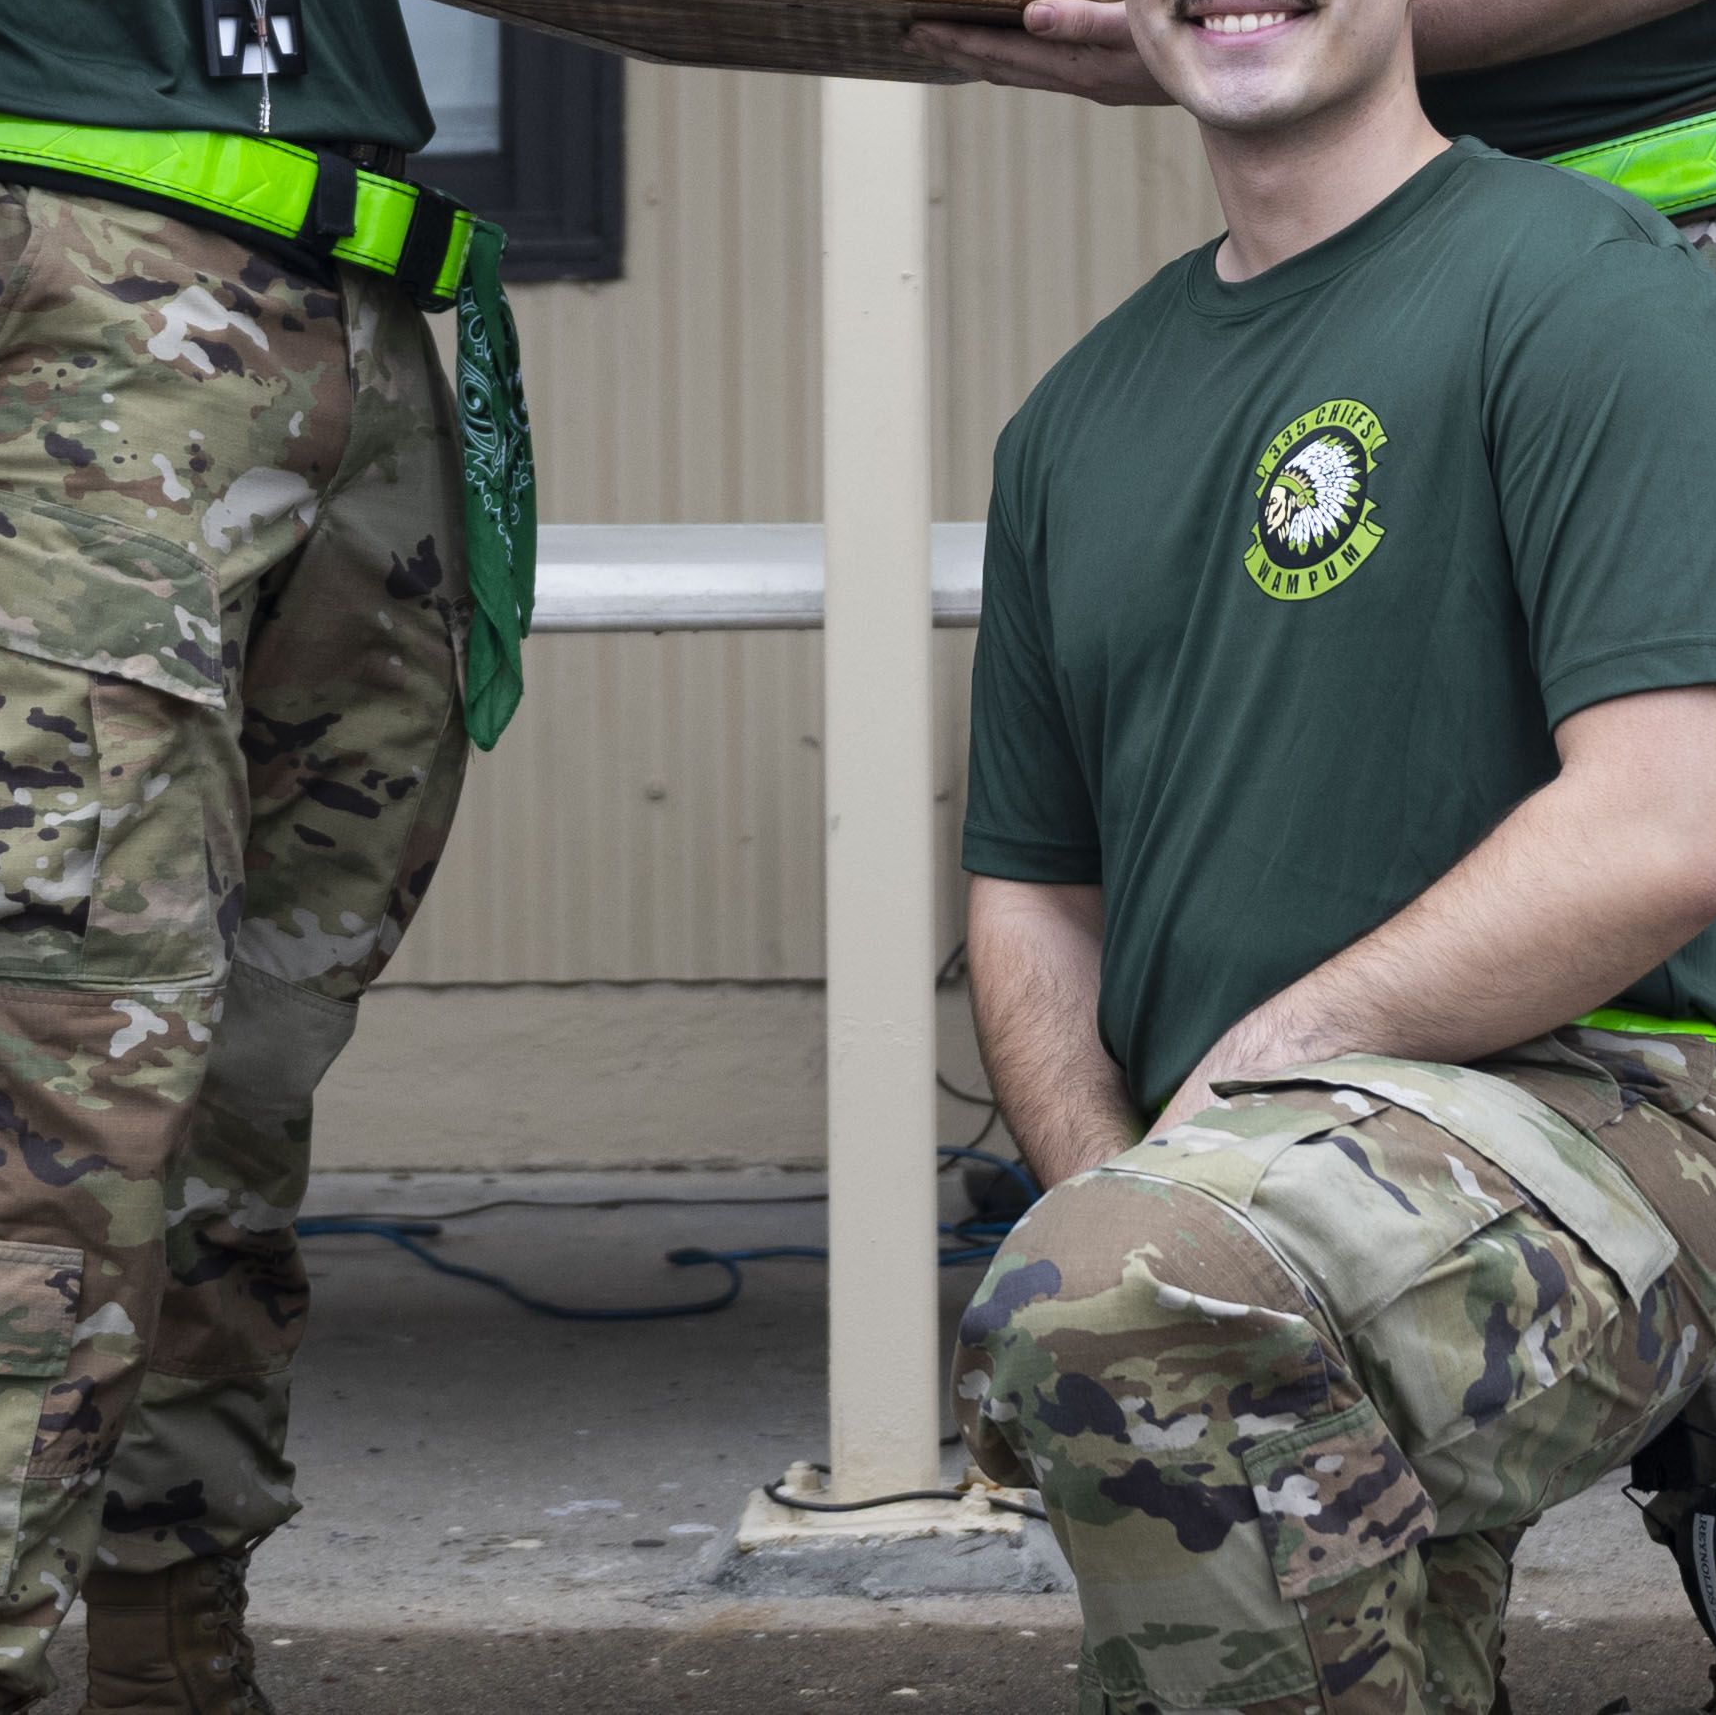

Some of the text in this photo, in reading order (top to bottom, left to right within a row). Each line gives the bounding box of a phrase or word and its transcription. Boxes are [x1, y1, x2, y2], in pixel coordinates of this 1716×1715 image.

[1268, 402, 1376, 460] 335 CHIEFS
[1257, 542, 1361, 595] WAMPUM
